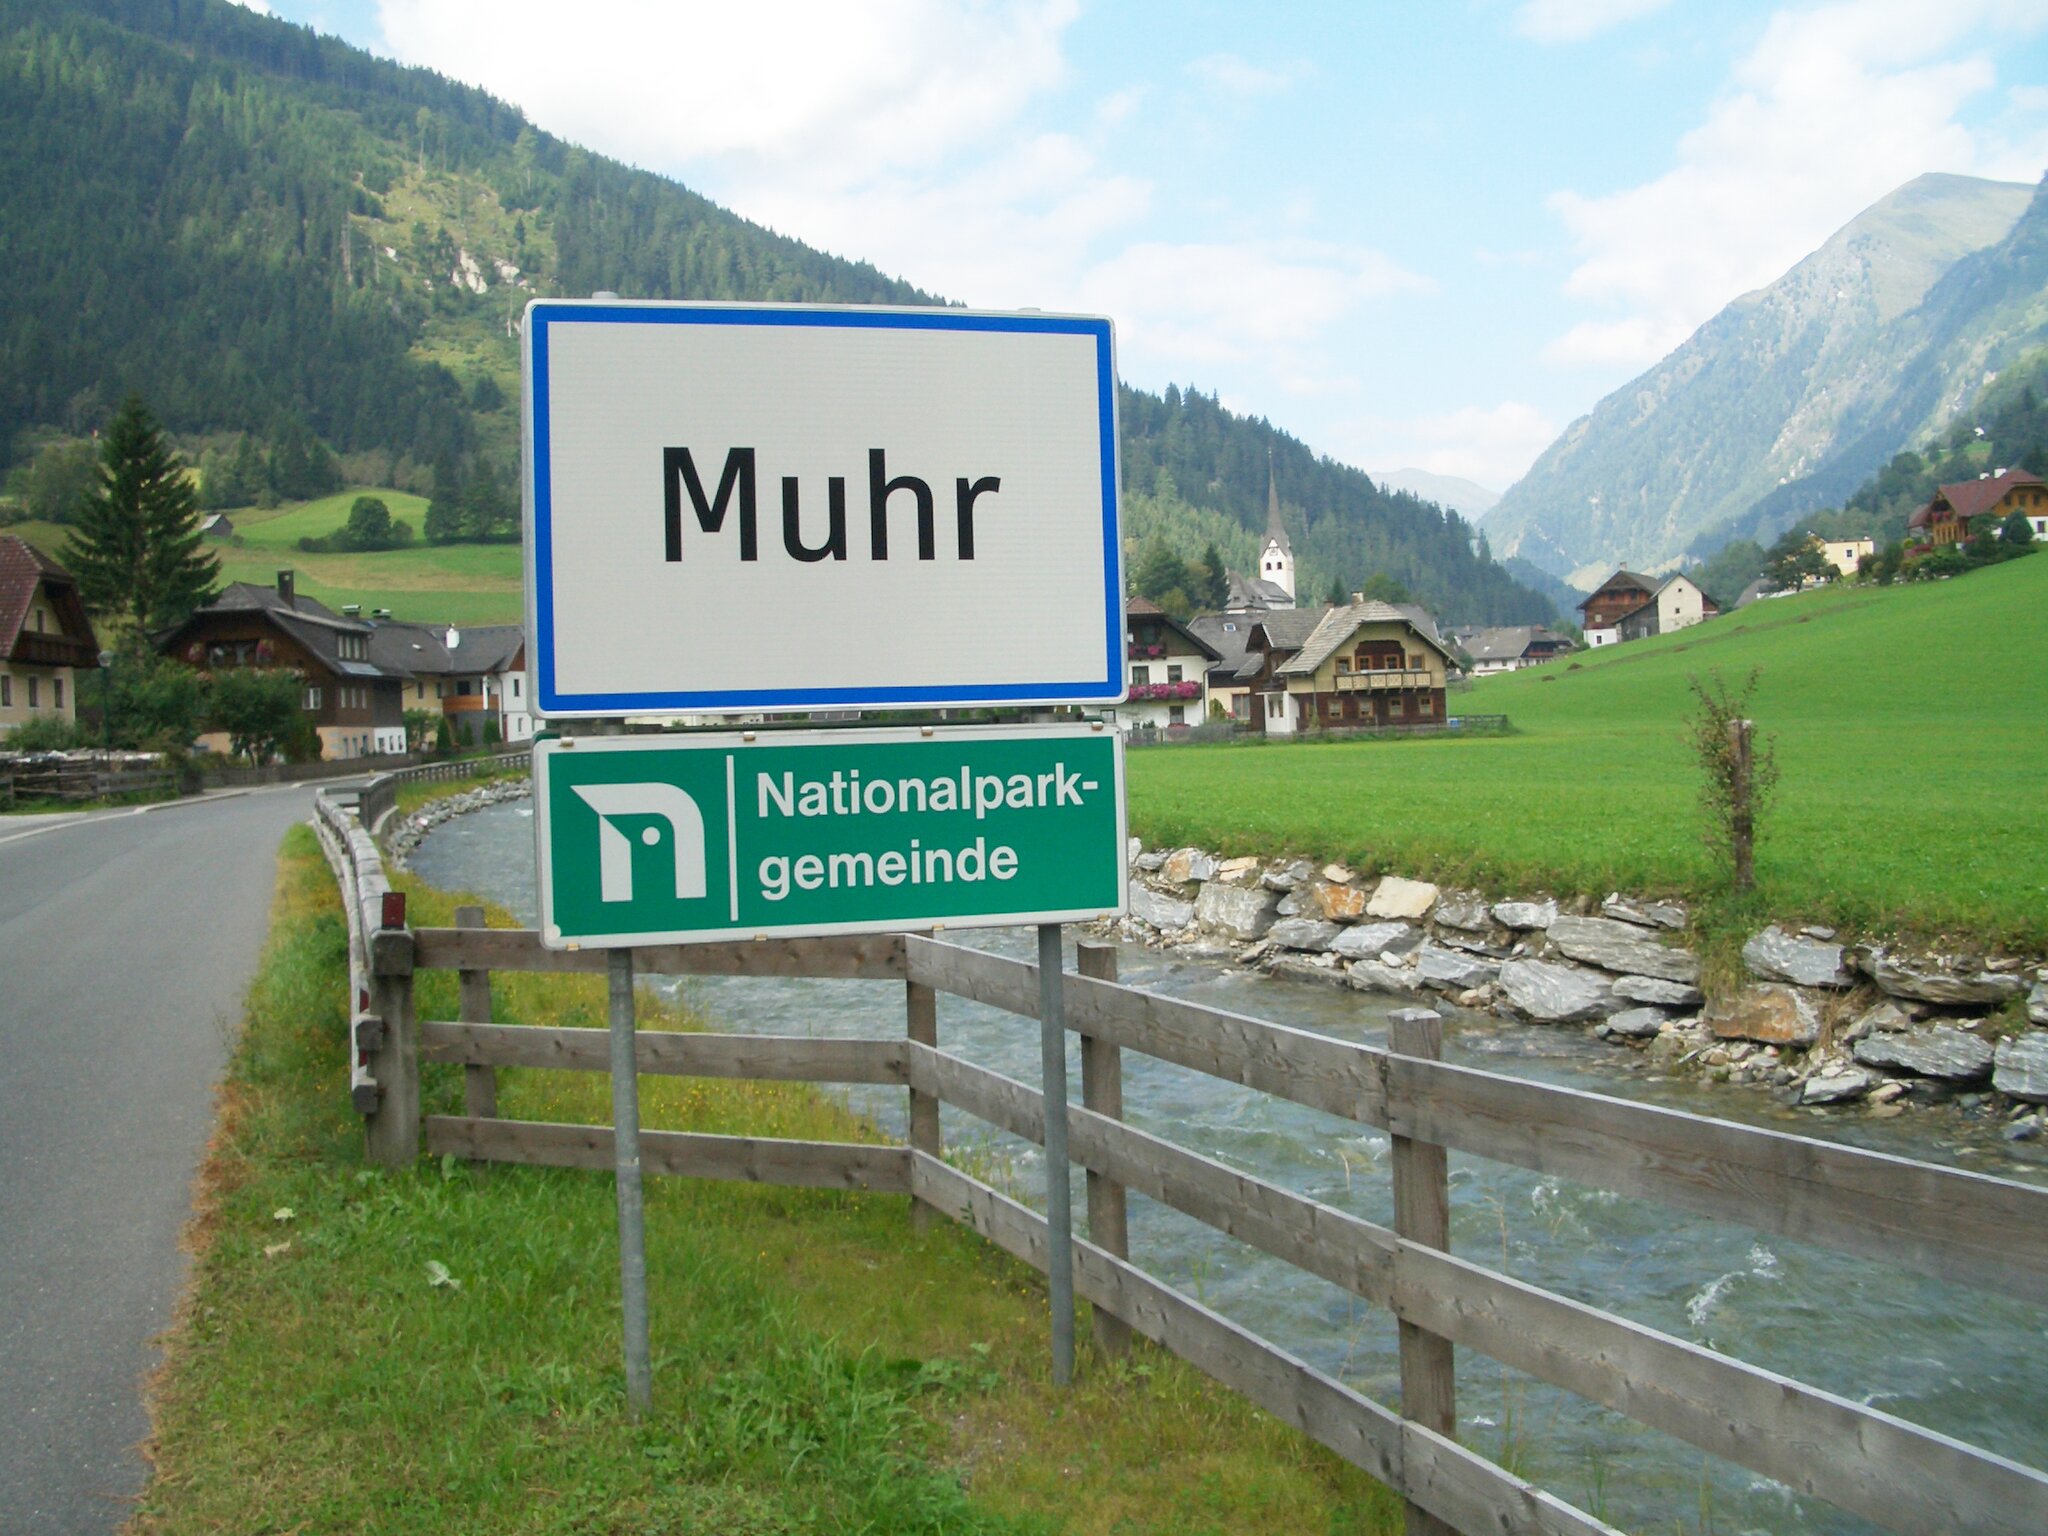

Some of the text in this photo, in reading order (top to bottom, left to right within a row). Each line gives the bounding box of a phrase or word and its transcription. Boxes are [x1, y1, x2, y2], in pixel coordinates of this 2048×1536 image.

[663, 446, 1001, 563] Muhr
[757, 762, 1099, 820] Nationalpark-
[758, 836, 1019, 901] gemeinde
